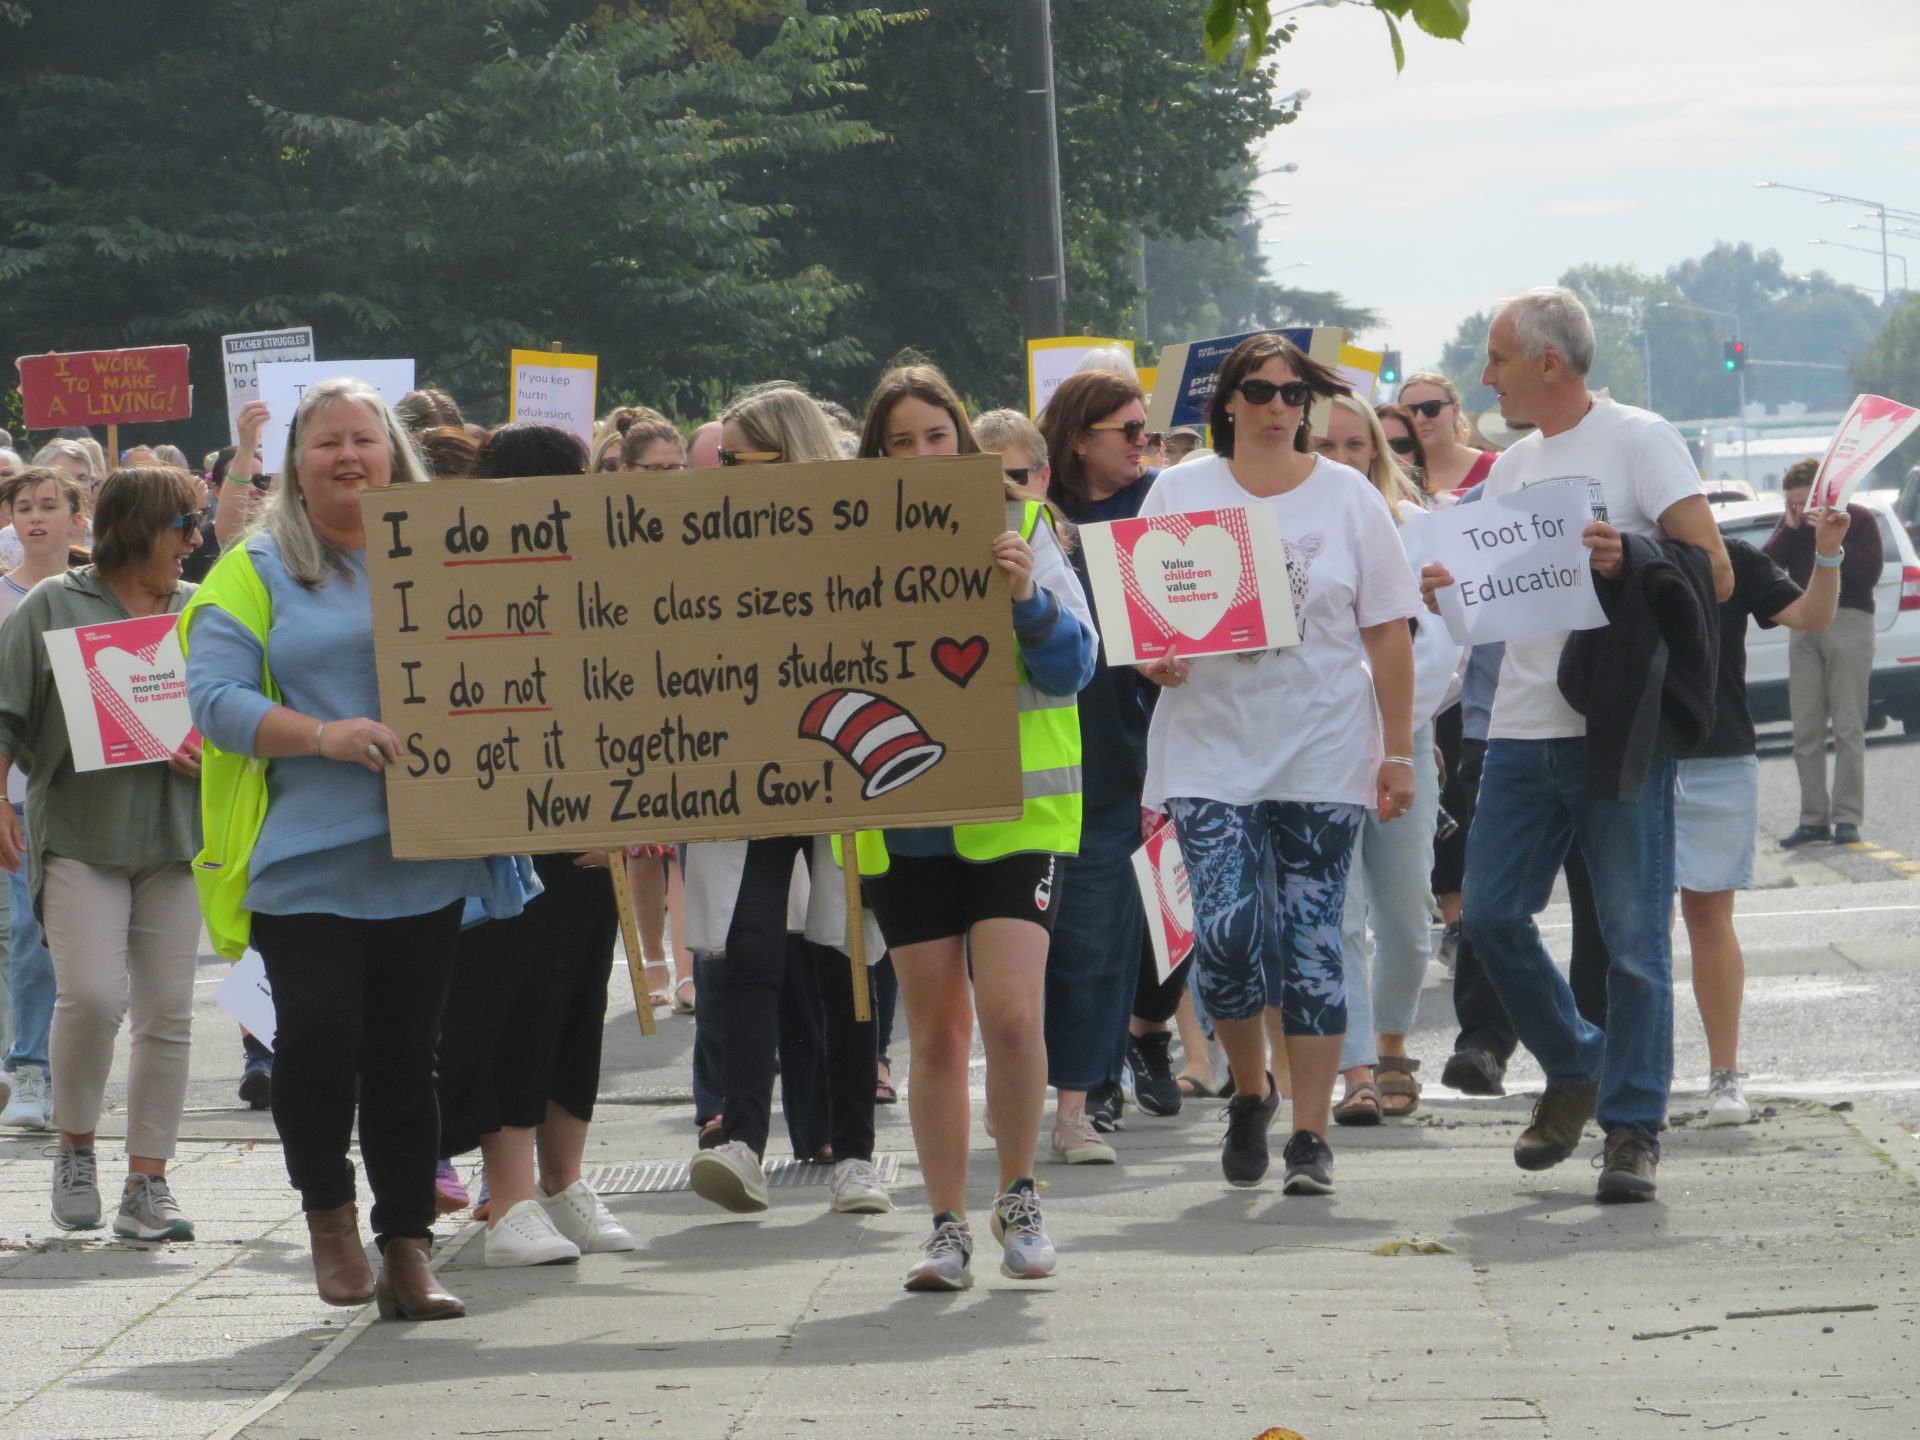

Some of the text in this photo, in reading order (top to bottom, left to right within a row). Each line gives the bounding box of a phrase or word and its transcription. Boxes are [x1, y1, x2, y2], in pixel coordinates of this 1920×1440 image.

[230, 335, 306, 351] TEACHER STRUGGLES
[55, 355, 149, 376] I WORK
[228, 361, 248, 374] I'm
[63, 375, 156, 393] TO MAKE
[233, 377, 246, 388] to
[519, 372, 570, 388] If you kep
[518, 389, 547, 401] hurtn
[1188, 384, 1217, 397] sch
[48, 385, 177, 418] A LIVING!
[383, 478, 960, 558] I do not like salaries so low,
[1462, 521, 1528, 551] Toot
[1531, 514, 1565, 540] for
[1161, 558, 1194, 570] Value
[1164, 569, 1212, 581] children
[1166, 581, 1197, 592] value
[393, 565, 993, 633] I do not like class sizes that GROW
[1168, 591, 1218, 603] teachers
[129, 669, 176, 683] We need
[401, 640, 917, 708] I do not like leaving students I
[132, 680, 186, 693] more time
[134, 694, 149, 703] for
[406, 714, 729, 790] So get it together
[526, 760, 834, 832] New Zealand Gov!
